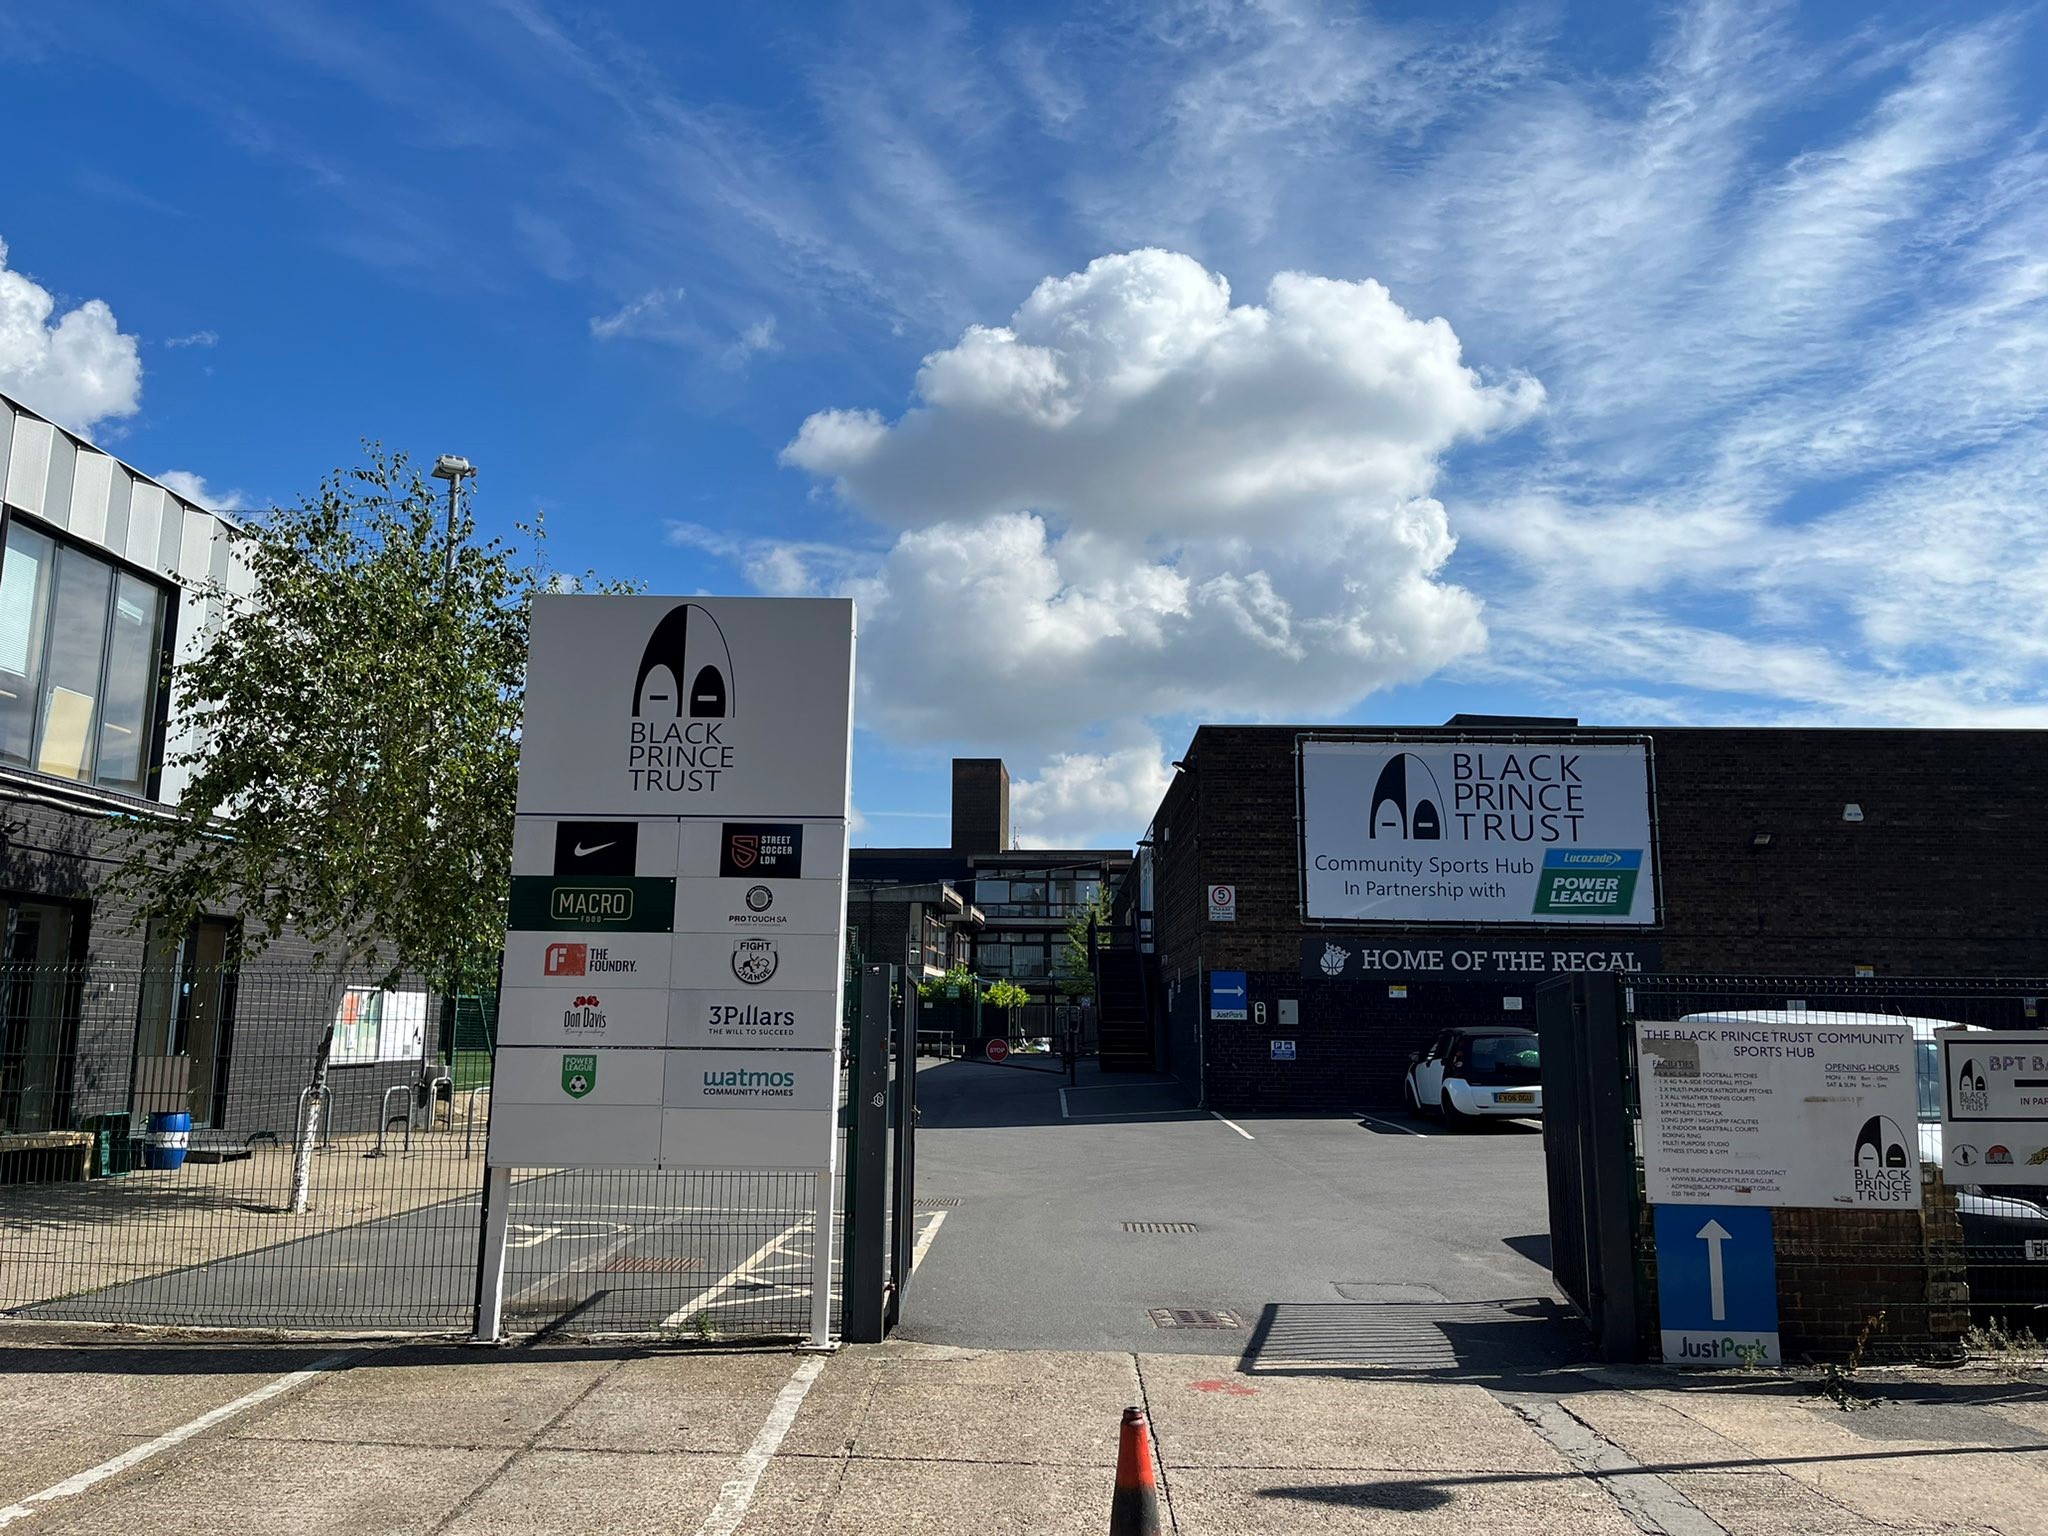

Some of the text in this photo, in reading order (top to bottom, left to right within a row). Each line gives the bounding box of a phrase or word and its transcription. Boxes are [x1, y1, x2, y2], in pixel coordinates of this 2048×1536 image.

[631, 722, 722, 744] BLACK
[629, 746, 734, 768] PRINCE
[1453, 753, 1582, 781] BLACK
[629, 770, 721, 792] TRUST
[1454, 783, 1584, 812] PRINCE
[1454, 813, 1584, 841] TRUST
[761, 835, 791, 844] STREET
[760, 845, 793, 855] SOCCER
[760, 856, 776, 864] LDN
[1564, 852, 1613, 865] Lucozade
[1314, 854, 1534, 877] Community Sports Hub
[1553, 877, 1619, 890] POWER
[1218, 890, 1225, 899] 5
[1344, 881, 1506, 901] In Partnership with
[1549, 890, 1618, 903] LEAGUE
[559, 893, 625, 914] MACRO
[740, 942, 771, 950] FIGHT
[590, 948, 608, 959] THE
[589, 960, 637, 973] FOUNDRY.
[1362, 950, 1641, 972] HOME OF THE REGAL
[738, 967, 771, 981] CHANGE
[564, 1007, 606, 1028] Don Davis
[709, 1004, 794, 1025] 3Pillars
[1644, 1030, 1904, 1044] THE BLACK PRINCE TRUST COMMUNITY
[1734, 1046, 1815, 1057] SPORTS HUB
[566, 1057, 593, 1065] POWER
[1989, 1056, 2026, 1071] BPT
[565, 1064, 593, 1072] LEAGUE
[704, 1068, 794, 1087] watmos
[703, 1088, 794, 1097] COMMUNITY HOMES
[1854, 1169, 1910, 1180] BLACK
[1855, 1180, 1911, 1191] PRINCE
[1856, 1191, 1911, 1202] TRUST
